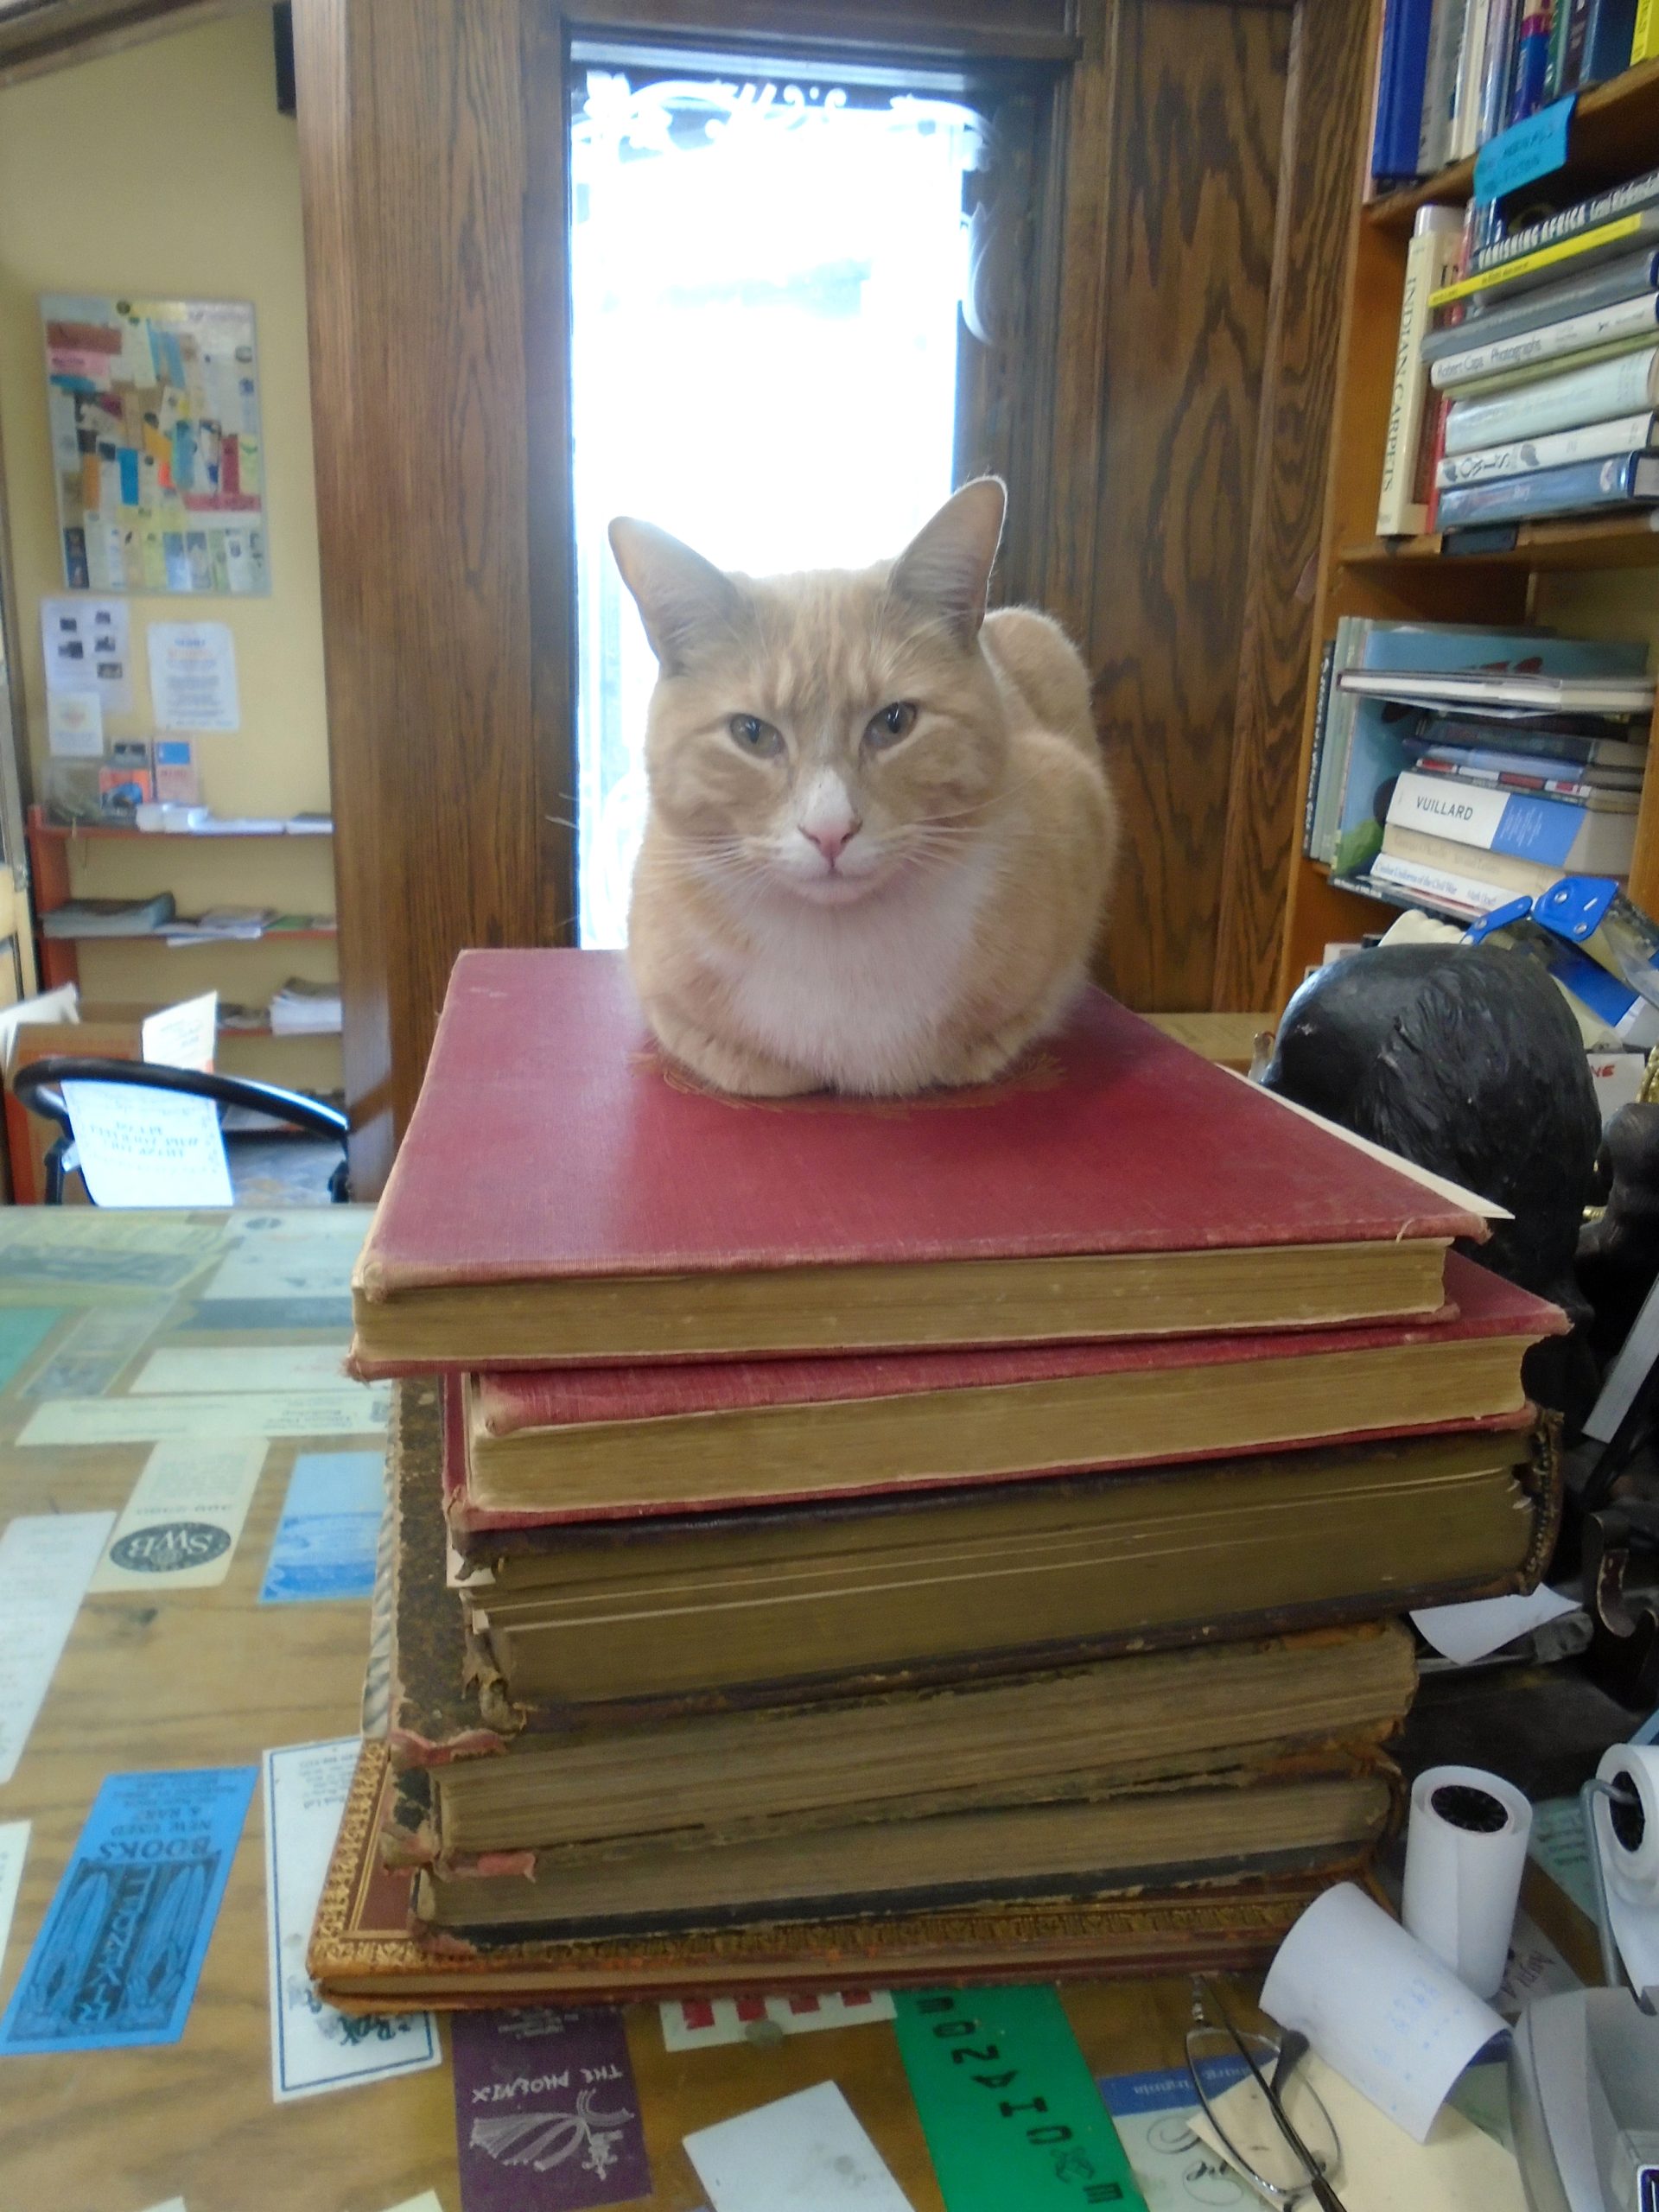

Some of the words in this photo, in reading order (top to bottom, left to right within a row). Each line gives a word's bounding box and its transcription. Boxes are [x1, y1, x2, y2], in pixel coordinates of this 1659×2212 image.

[1541, 203, 1586, 244] AFRICA
[1395, 276, 1417, 376] INDIAN
[1491, 336, 1542, 361] Photographs
[1384, 384, 1405, 493] CARPETS
[1415, 796, 1474, 822] VUILLARD
[128, 1528, 213, 1559] SWB
[99, 1837, 212, 1859] BOOKS
[471, 2069, 569, 2104] PHOENIX
[580, 2063, 623, 2083] THE
